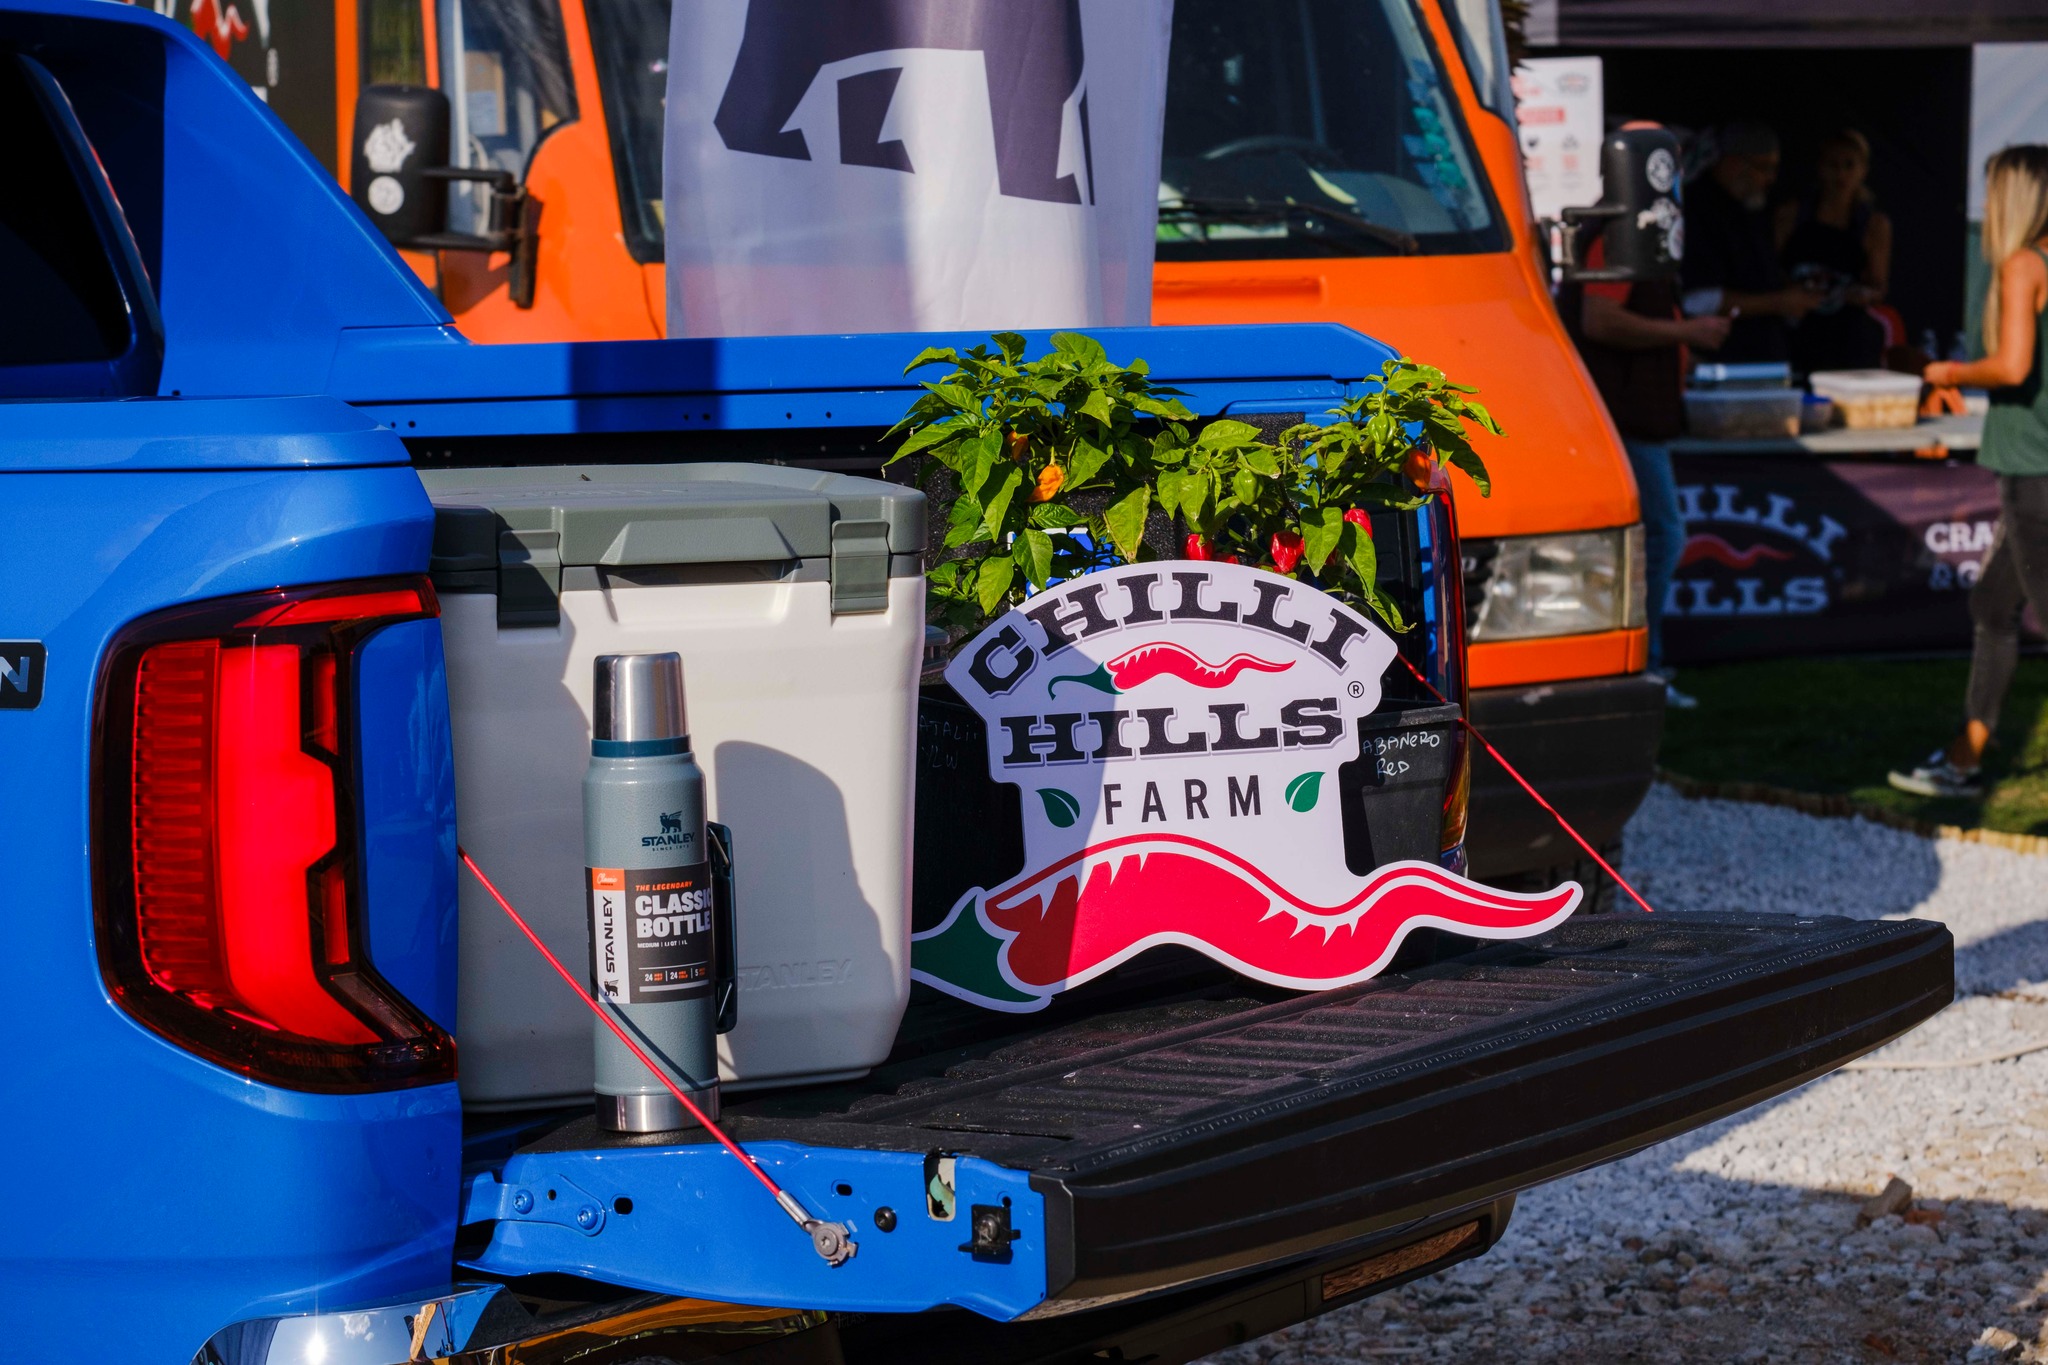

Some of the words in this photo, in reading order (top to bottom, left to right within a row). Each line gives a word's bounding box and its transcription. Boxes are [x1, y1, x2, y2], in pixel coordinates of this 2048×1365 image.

[1677, 483, 1849, 564] ILLI
[1925, 521, 2000, 553] CRA
[1663, 574, 1830, 618] ILLS
[968, 572, 1369, 697] CHILLI
[919, 714, 978, 742] ATALii
[1001, 697, 1343, 764] HILLS
[1362, 731, 1440, 756] ABANeRO
[1105, 774, 1263, 825] FARM
[642, 832, 695, 846] STANLEY
[635, 888, 711, 916] CLASSIC
[652, 881, 693, 891] LEGENDARY
[603, 896, 615, 973] STANLEY
[636, 911, 711, 939] BOTTLE
[644, 973, 654, 982] 24
[670, 971, 678, 980] 24
[737, 958, 852, 992] TANLEY
